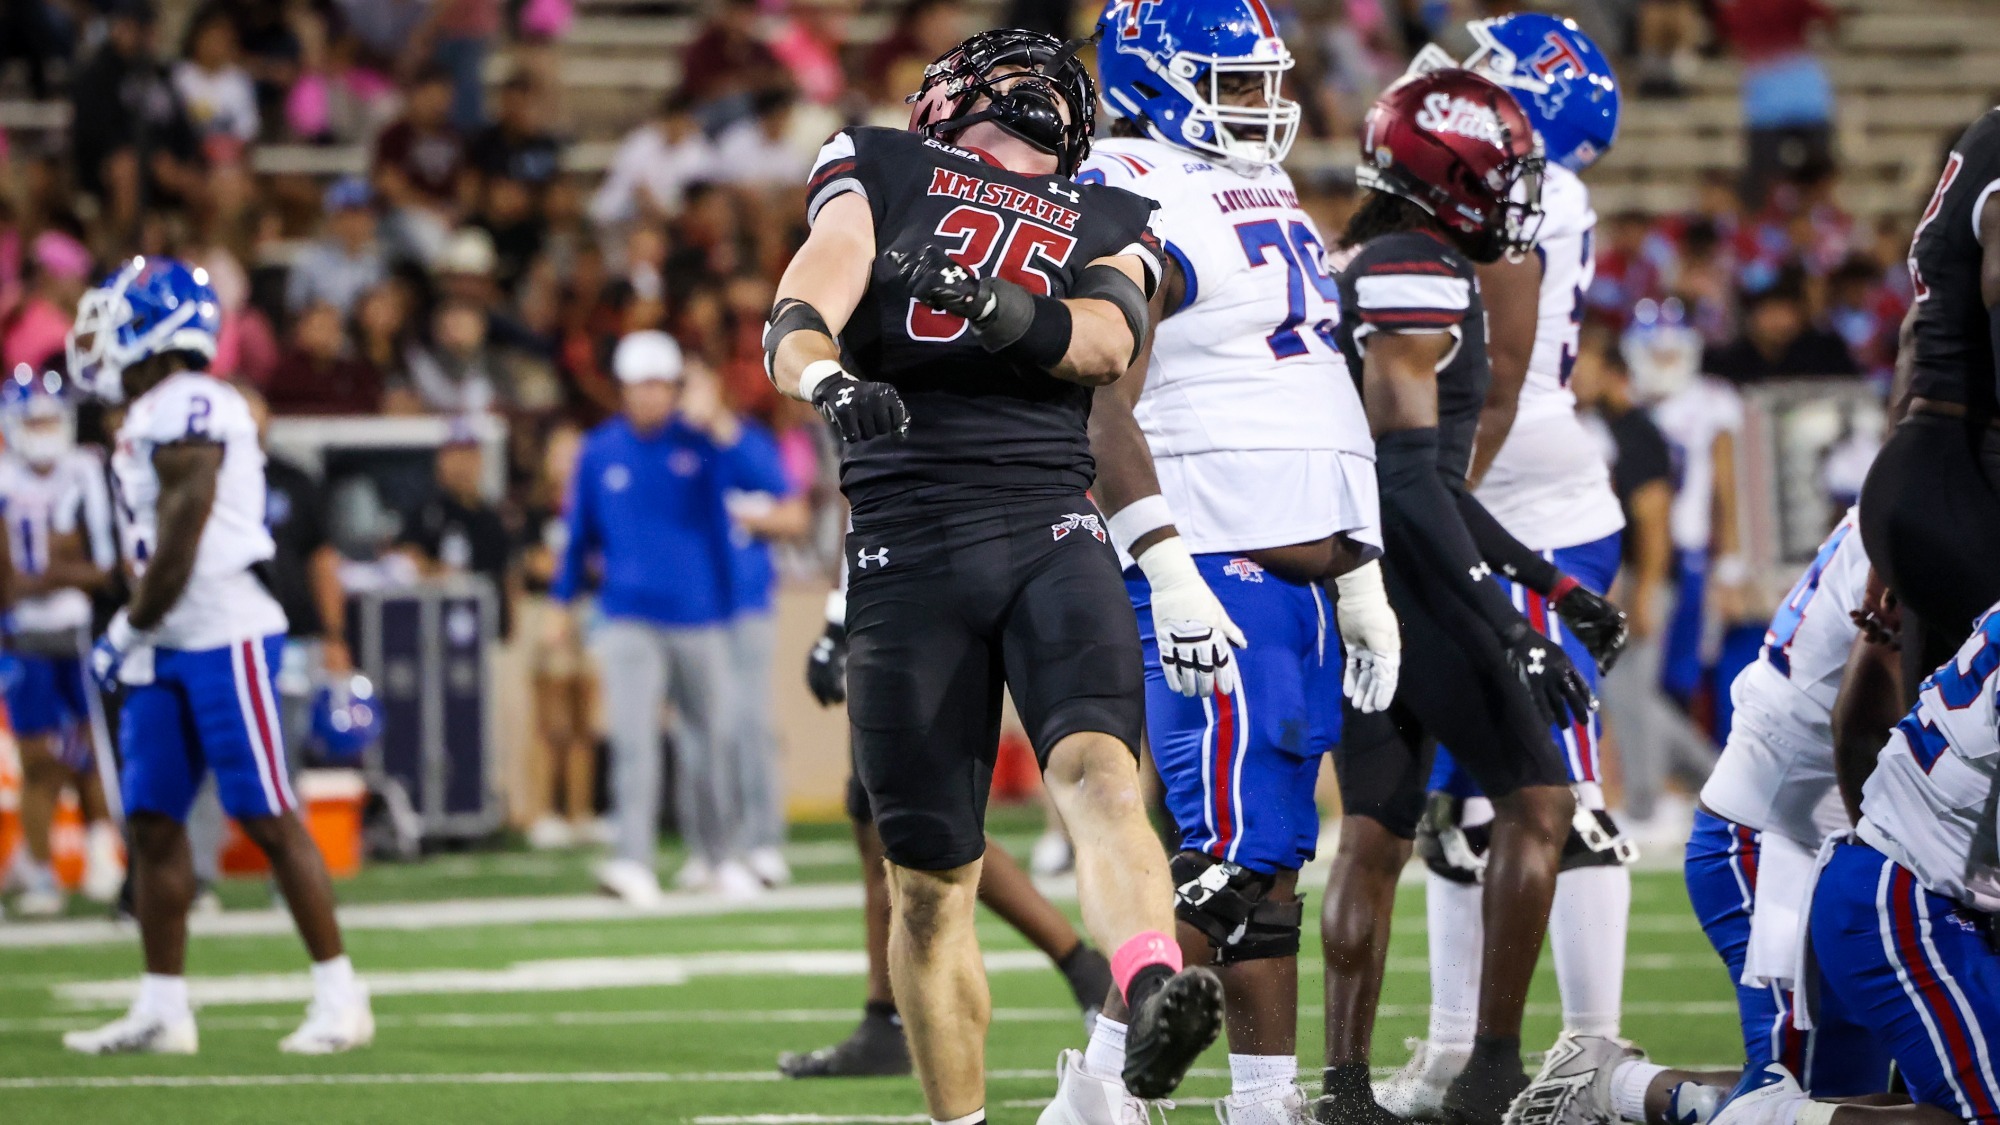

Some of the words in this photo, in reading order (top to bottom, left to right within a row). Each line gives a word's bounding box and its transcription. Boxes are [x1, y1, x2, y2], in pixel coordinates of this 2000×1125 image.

[927, 167, 984, 202] NM
[979, 182, 1081, 232] STATE
[906, 204, 1079, 343] 35
[1233, 218, 1343, 361] 79
[188, 396, 211, 435] 2
